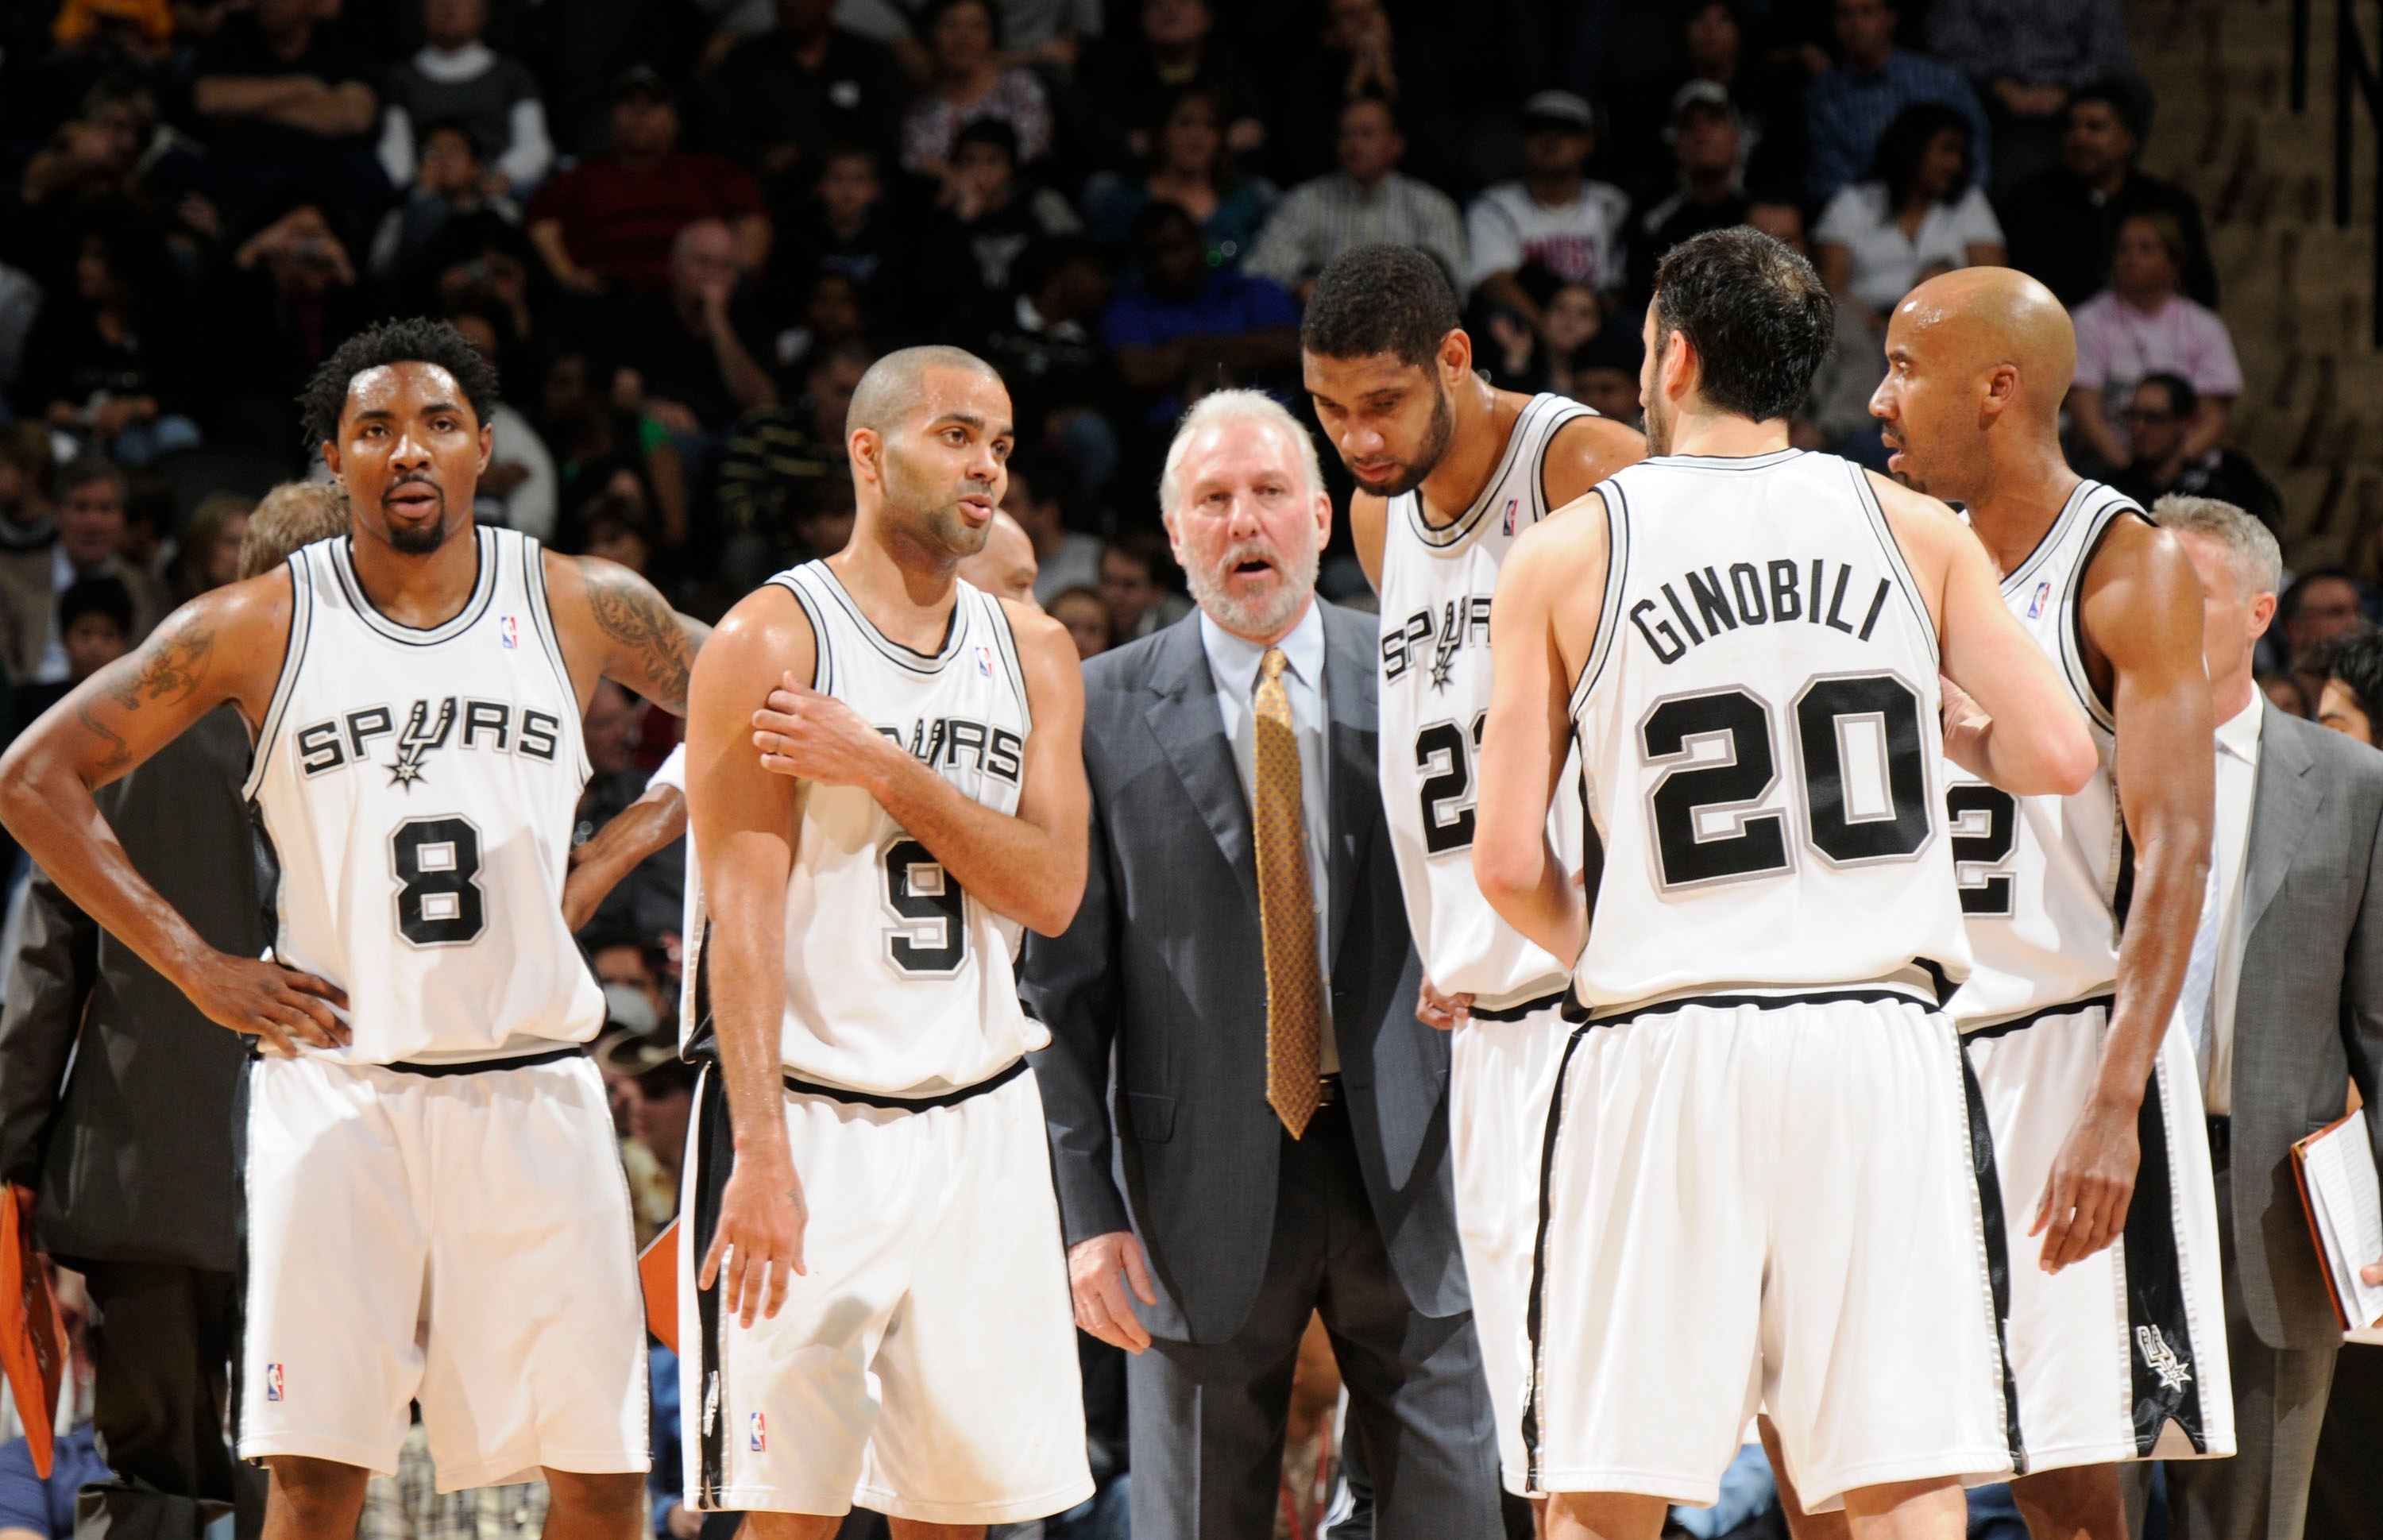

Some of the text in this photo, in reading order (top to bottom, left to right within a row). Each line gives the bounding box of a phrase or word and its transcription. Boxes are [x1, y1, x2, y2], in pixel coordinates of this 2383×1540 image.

[1381, 595, 1491, 696] SPUR
[1630, 558, 1891, 665] GINOBILI
[295, 696, 561, 795] SPURS
[1416, 706, 1489, 857] 2
[1635, 668, 1937, 894] 20
[387, 812, 489, 951] 8
[877, 832, 971, 982] 9
